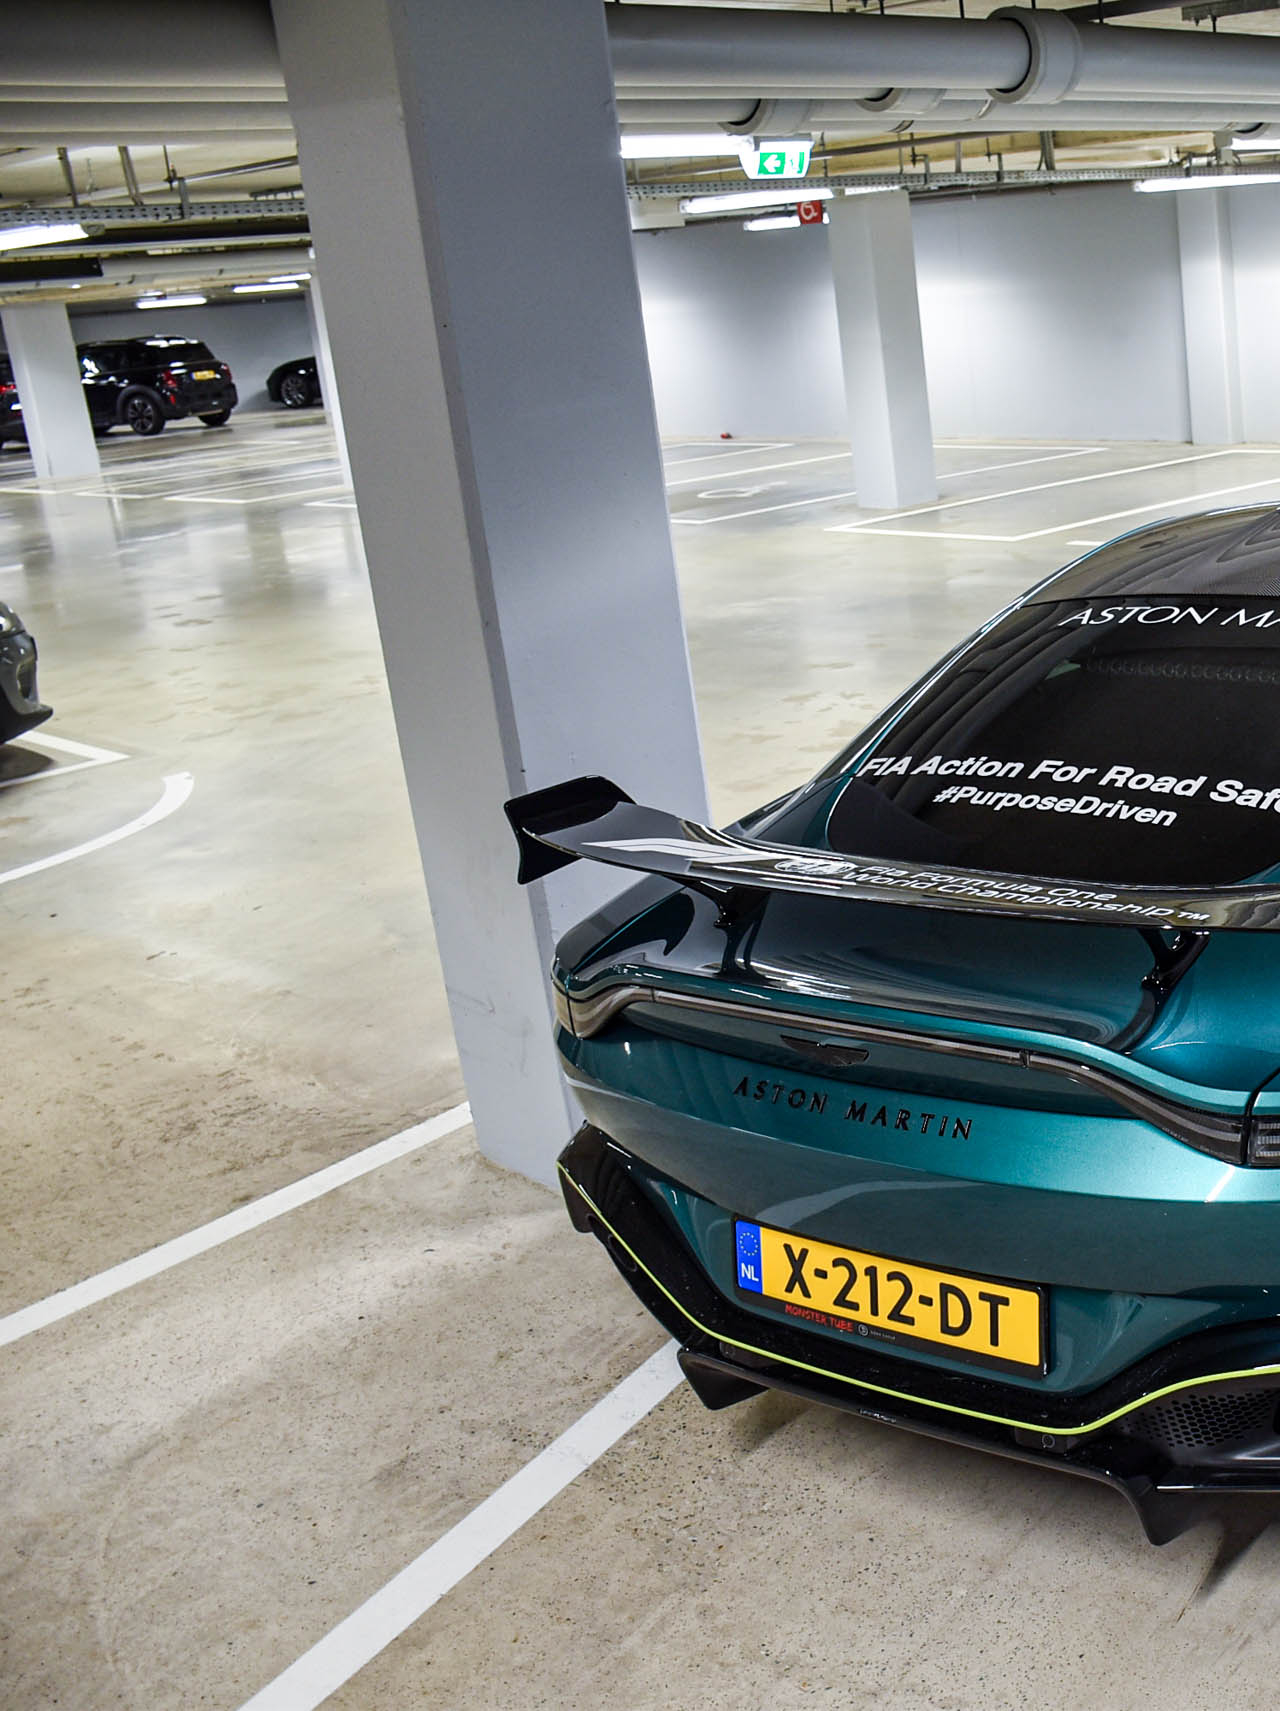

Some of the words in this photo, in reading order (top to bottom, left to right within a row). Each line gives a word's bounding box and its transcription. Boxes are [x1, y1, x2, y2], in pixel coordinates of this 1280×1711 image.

[1058, 606, 1218, 626] ASTON
[856, 756, 912, 777] FIA
[911, 755, 1024, 778] Action
[1028, 759, 1098, 783] For
[1098, 765, 1208, 797] Road
[933, 785, 1178, 827] #PurposeDriven
[843, 872, 936, 890] World
[857, 865, 908, 878] Fia
[910, 871, 1043, 893] Formula
[1047, 887, 1117, 901] One
[734, 1077, 828, 1114] ASTON
[843, 1100, 974, 1141] MARTIN
[741, 1262, 759, 1282] NL
[783, 1243, 1010, 1347] X-212-DT
